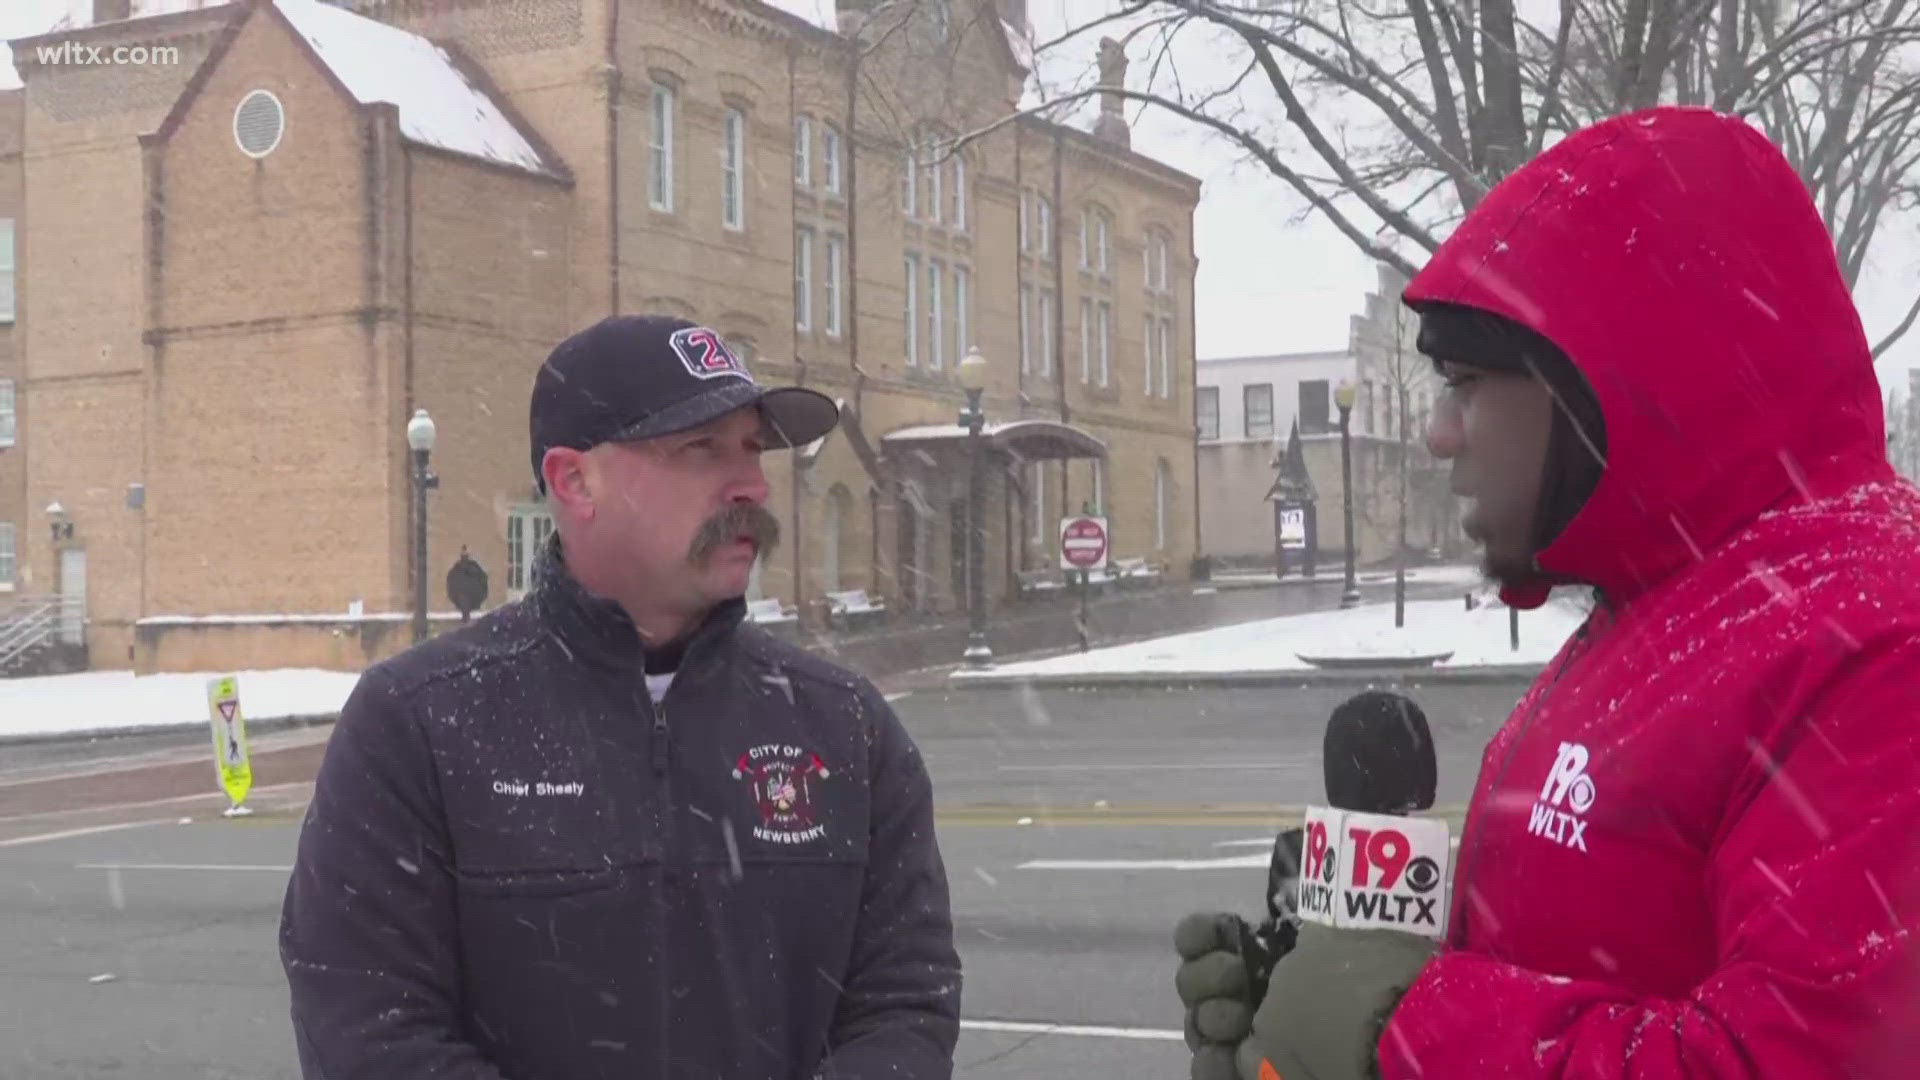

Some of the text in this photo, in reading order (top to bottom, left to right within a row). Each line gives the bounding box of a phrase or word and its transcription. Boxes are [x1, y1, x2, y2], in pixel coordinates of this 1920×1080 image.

[749, 744, 803, 760] CITY OF
[493, 780, 529, 797] Chief
[1540, 741, 1589, 806] 19
[753, 823, 827, 844] NEWBERRY
[1527, 801, 1588, 853] WLTX
[1306, 821, 1327, 880] 19
[1349, 828, 1411, 890] 19
[1301, 883, 1333, 915] WLTX
[1344, 890, 1436, 926] WLTX
